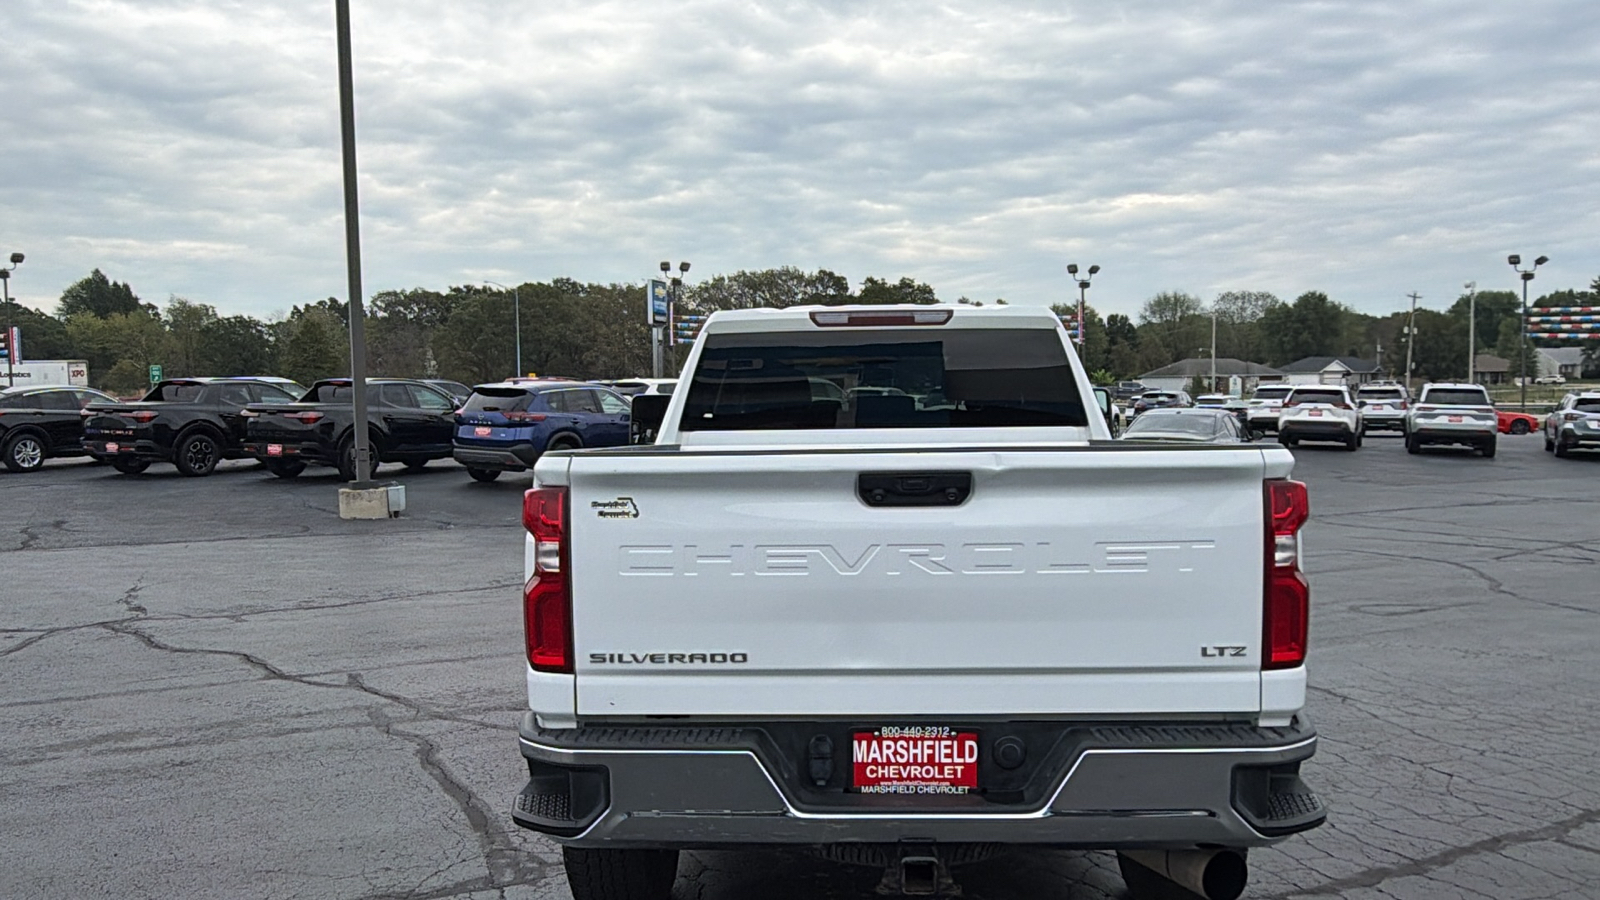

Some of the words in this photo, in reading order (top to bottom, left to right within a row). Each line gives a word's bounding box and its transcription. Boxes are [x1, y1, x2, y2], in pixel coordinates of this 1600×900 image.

[619, 540, 1215, 576] CHEVROLET
[589, 652, 748, 664] SILVERADO
[1200, 645, 1247, 658] LTZ
[881, 726, 950, 737] 800-440-2312
[852, 739, 978, 764] MARSHFIELD
[865, 765, 965, 779] CHEVROLET
[861, 785, 916, 794] MARSHFIELD
[917, 785, 970, 794] CHEVROLET
